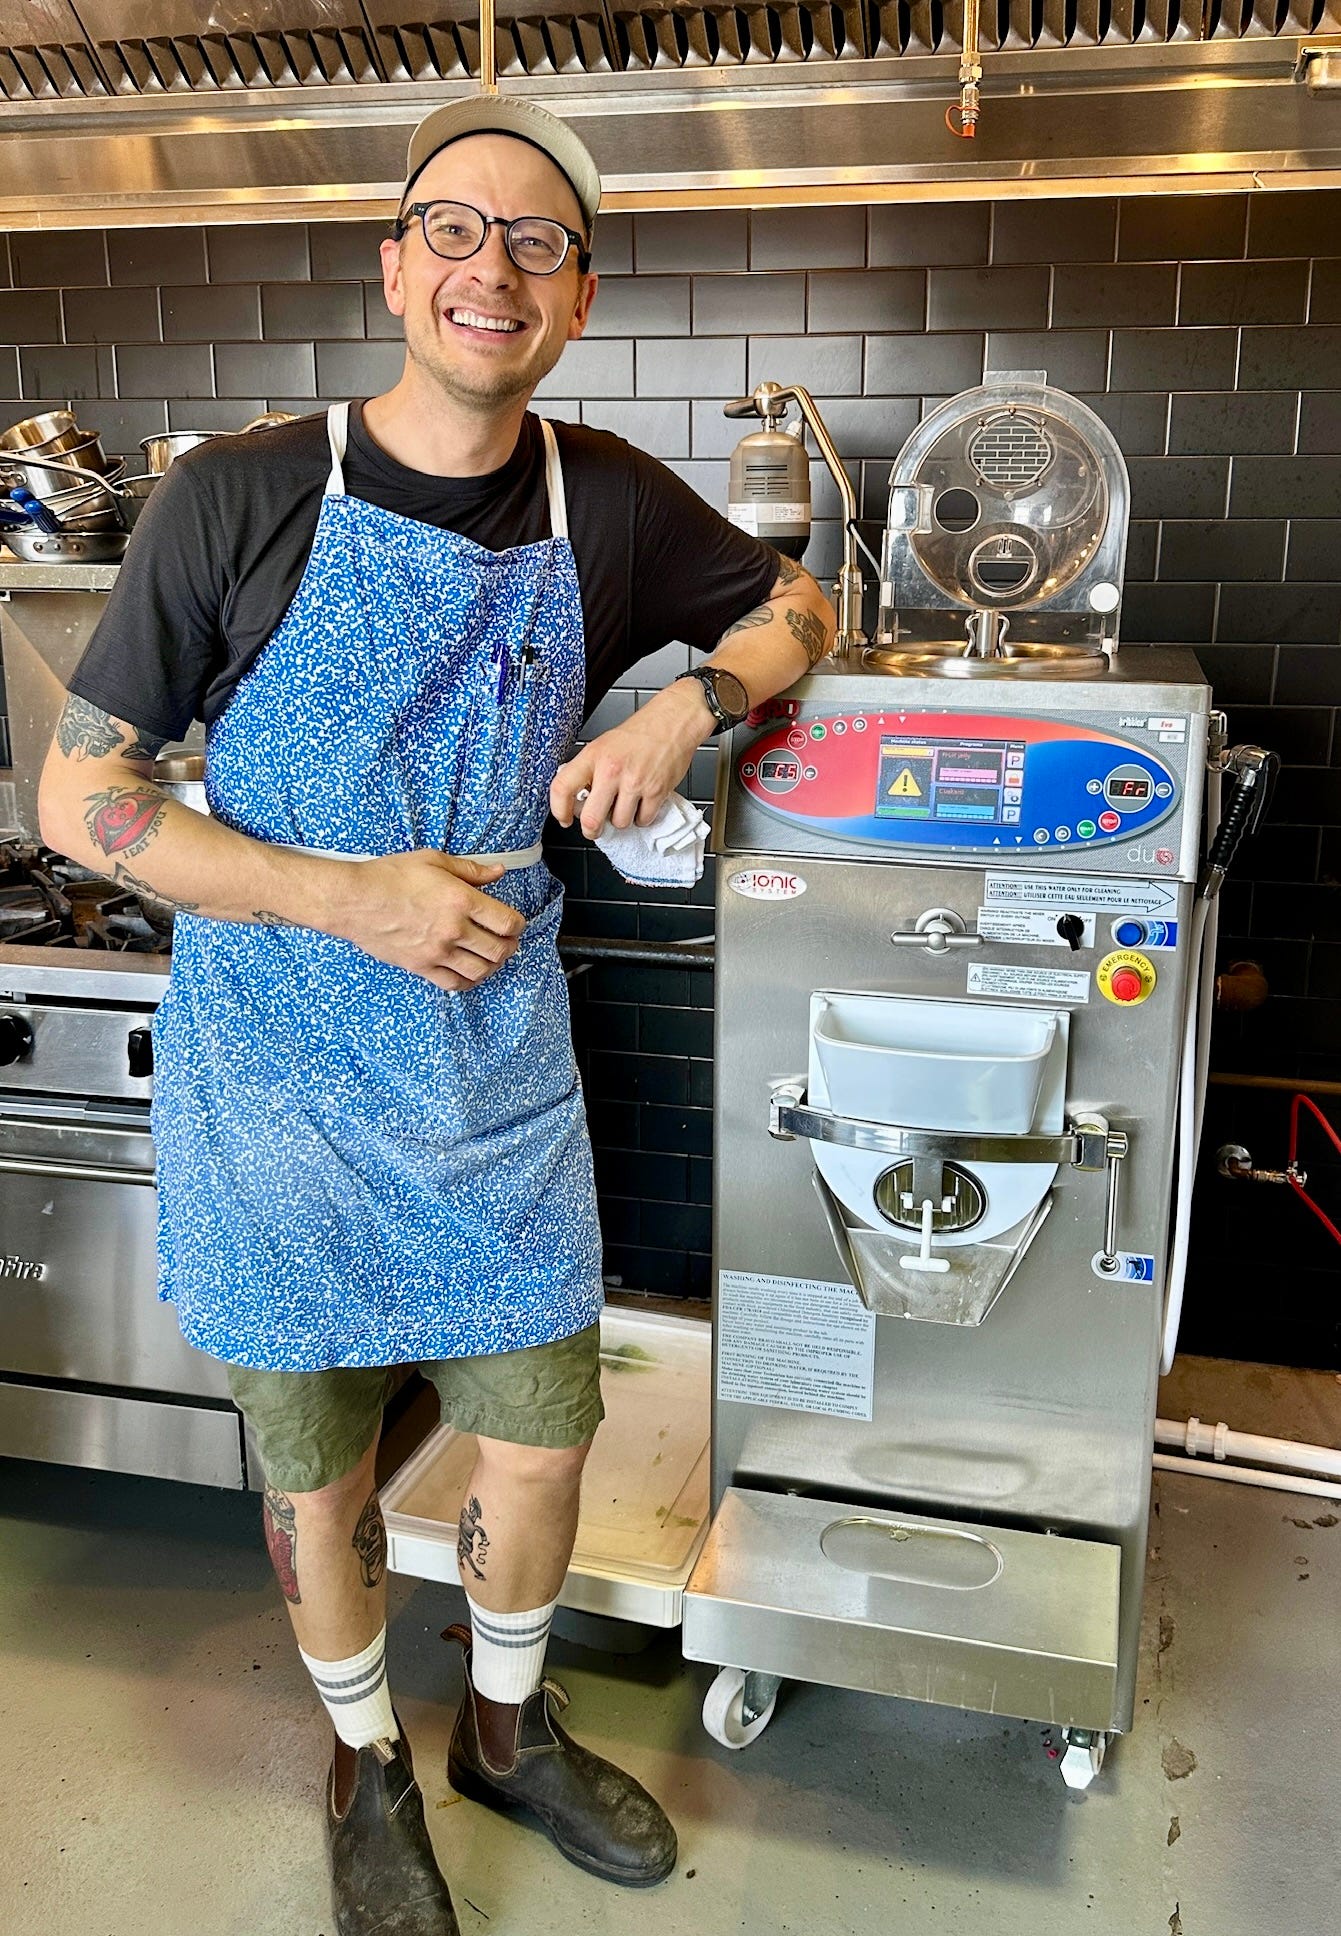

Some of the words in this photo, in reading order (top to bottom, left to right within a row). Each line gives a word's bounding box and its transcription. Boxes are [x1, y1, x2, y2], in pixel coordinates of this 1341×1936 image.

[1102, 953, 1150, 972] EMERGENCY
[723, 1274, 754, 1282] WASHING
[772, 1279, 821, 1290] DISINFECTING
